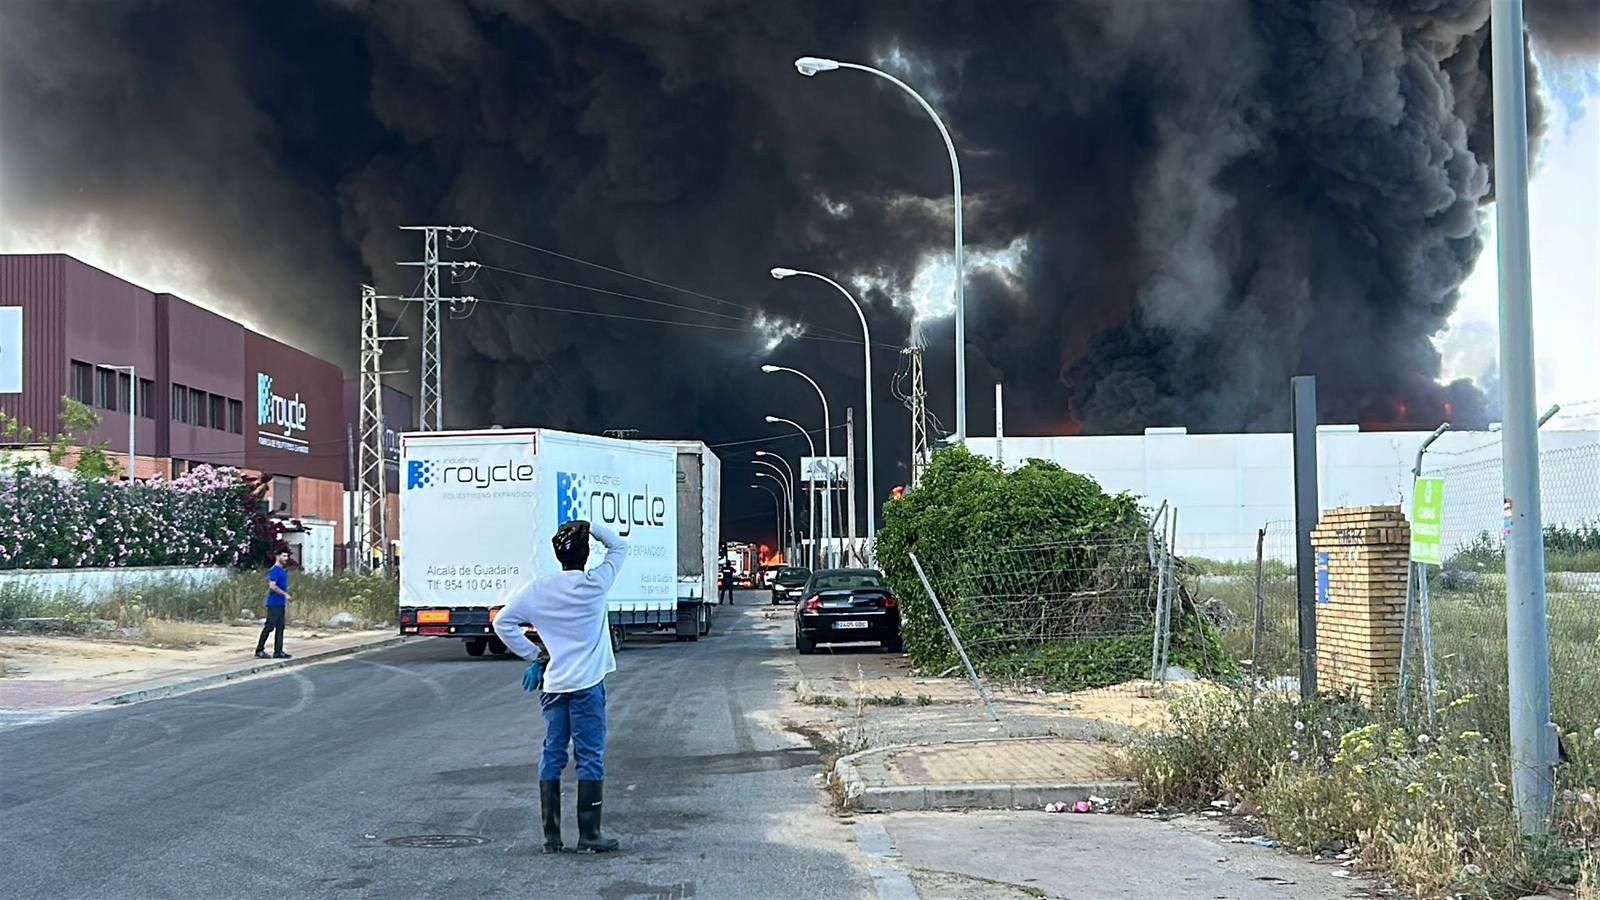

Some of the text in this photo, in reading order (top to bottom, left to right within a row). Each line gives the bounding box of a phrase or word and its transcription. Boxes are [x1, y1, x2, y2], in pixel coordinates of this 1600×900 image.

[272, 392, 306, 436] roycle
[443, 459, 534, 489] roycle
[589, 483, 666, 537] roycle
[444, 579, 463, 591] 954
[466, 579, 478, 590] 10
[480, 579, 492, 590] 04
[495, 579, 507, 590] 61
[458, 564, 471, 576] de
